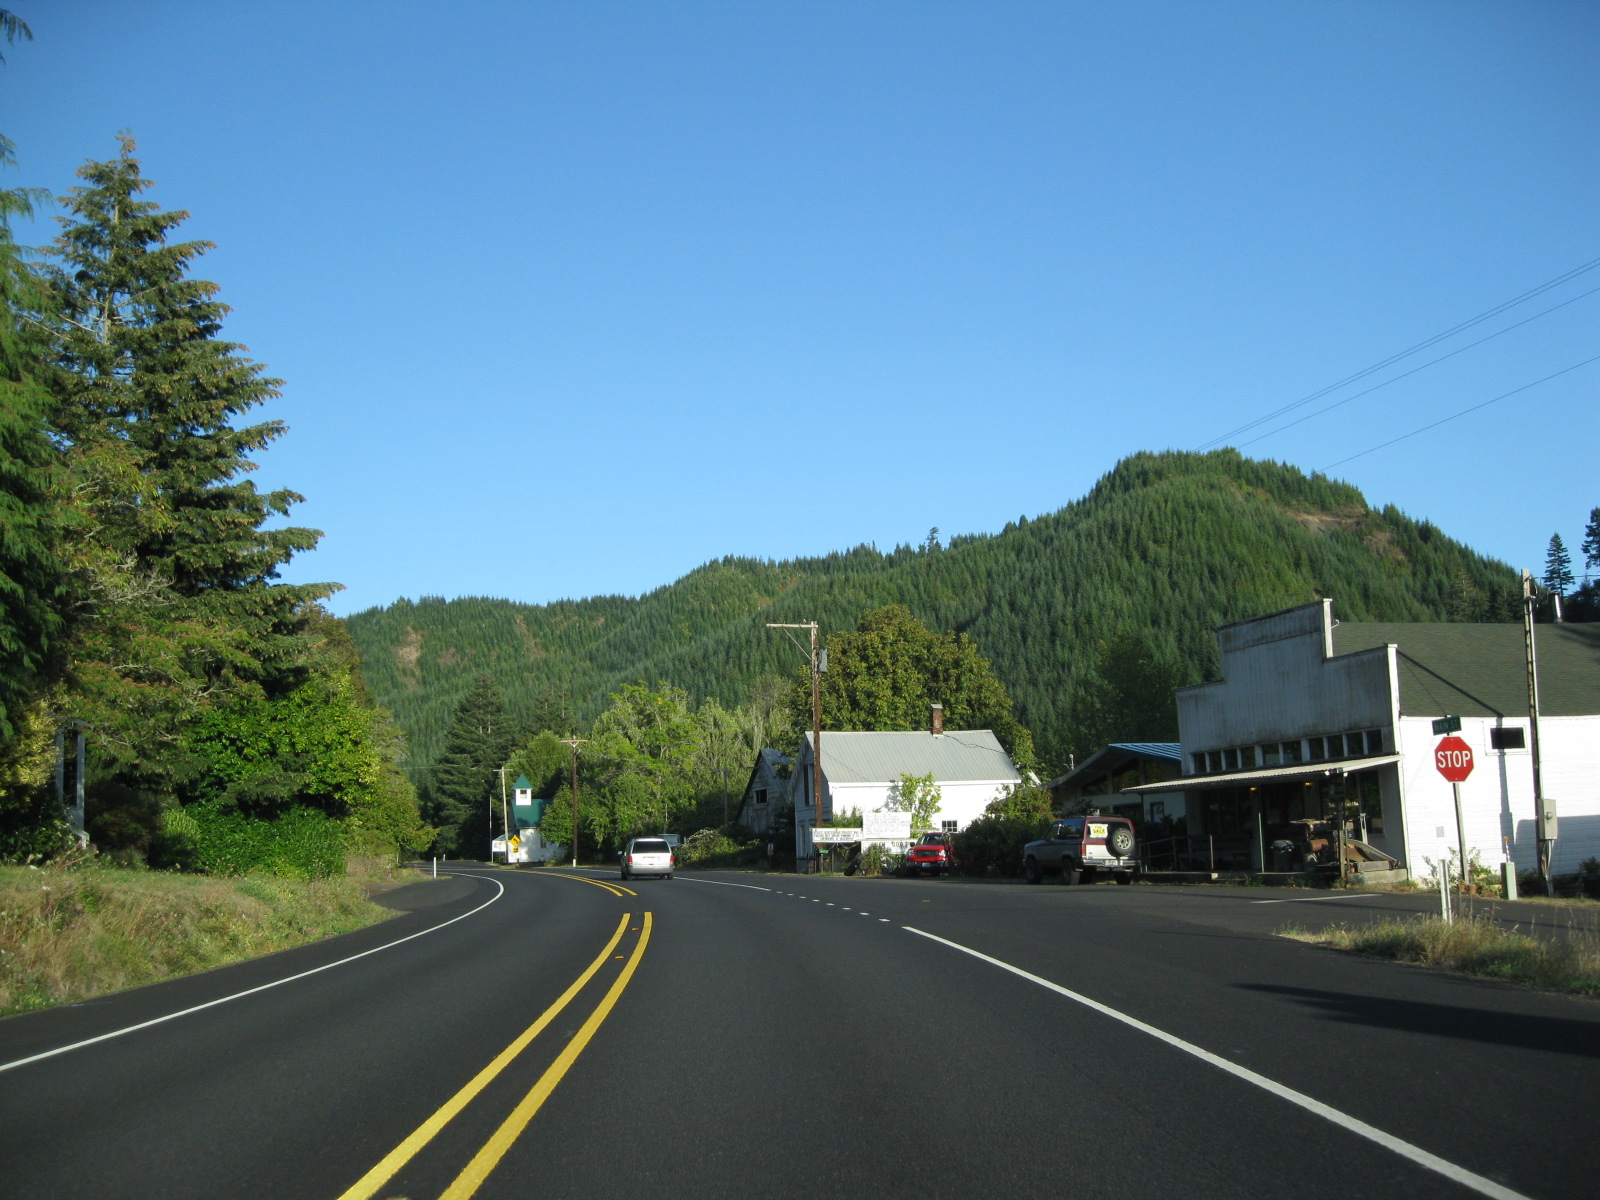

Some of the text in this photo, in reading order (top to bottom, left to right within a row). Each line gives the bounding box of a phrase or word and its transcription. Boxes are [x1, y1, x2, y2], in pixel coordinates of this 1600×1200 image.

[1434, 719, 1458, 730] MAIN ST
[1437, 750, 1471, 768] STOP
